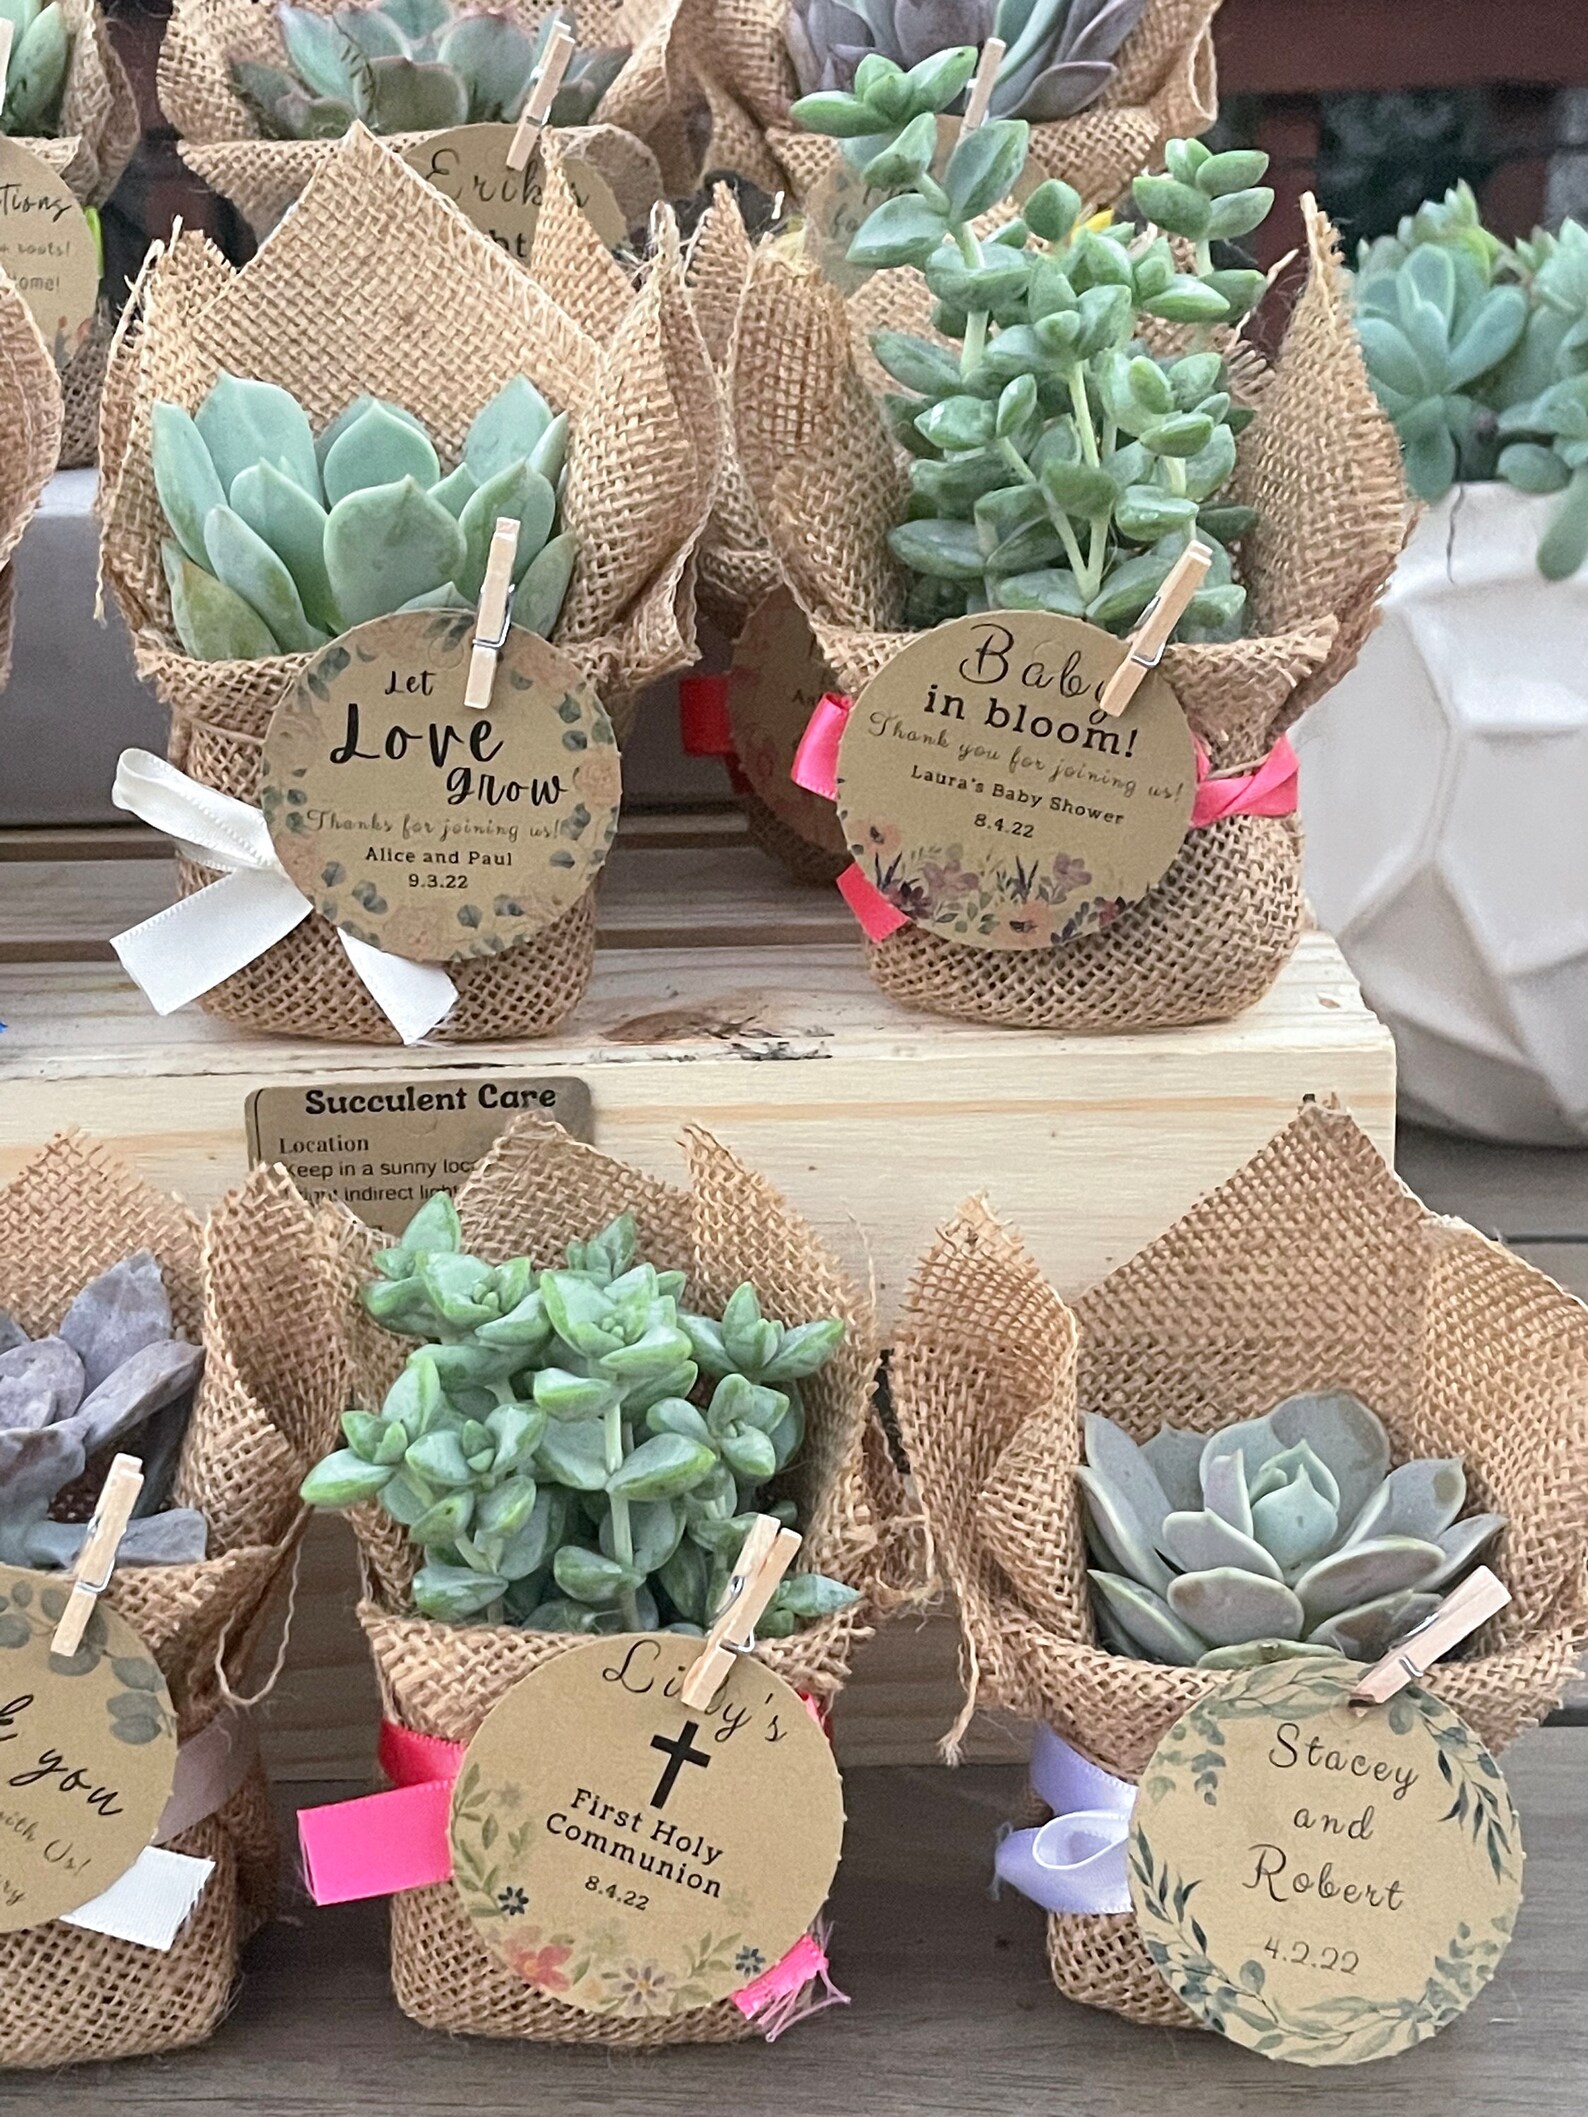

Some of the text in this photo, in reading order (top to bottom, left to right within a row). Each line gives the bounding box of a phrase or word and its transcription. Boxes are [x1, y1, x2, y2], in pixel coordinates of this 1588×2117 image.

[14, 275, 60, 292] ome!
[384, 670, 437, 696] Let
[329, 703, 504, 768] Love
[923, 684, 1139, 758] in bloom!
[869, 710, 1183, 804] Thank you for joining us!
[446, 766, 568, 807] grow
[910, 765, 1125, 826] Laura's Baby Shower
[306, 809, 561, 843] Thanks for joining us!
[974, 813, 1035, 839] 8.4.22
[365, 846, 512, 867] Alice and Paul
[408, 873, 469, 889] 9.3.22
[305, 1083, 556, 1115] Succulent Care
[279, 1134, 369, 1155] Location
[339, 1161, 356, 1177] in
[362, 1164, 374, 1176] a
[380, 1161, 437, 1178] sunny
[344, 1186, 414, 1202] indirect
[1268, 1722, 1420, 1801] Stacey
[8, 1748, 124, 1816] you
[570, 1788, 724, 1866] First Holy
[1294, 1805, 1375, 1841] and
[44, 1839, 92, 1876] Us!
[546, 1812, 722, 1898] Communion
[584, 1874, 650, 1911] 8.4.22
[1242, 1843, 1406, 1912] Robert
[1264, 1936, 1360, 1976] 4.2.22
